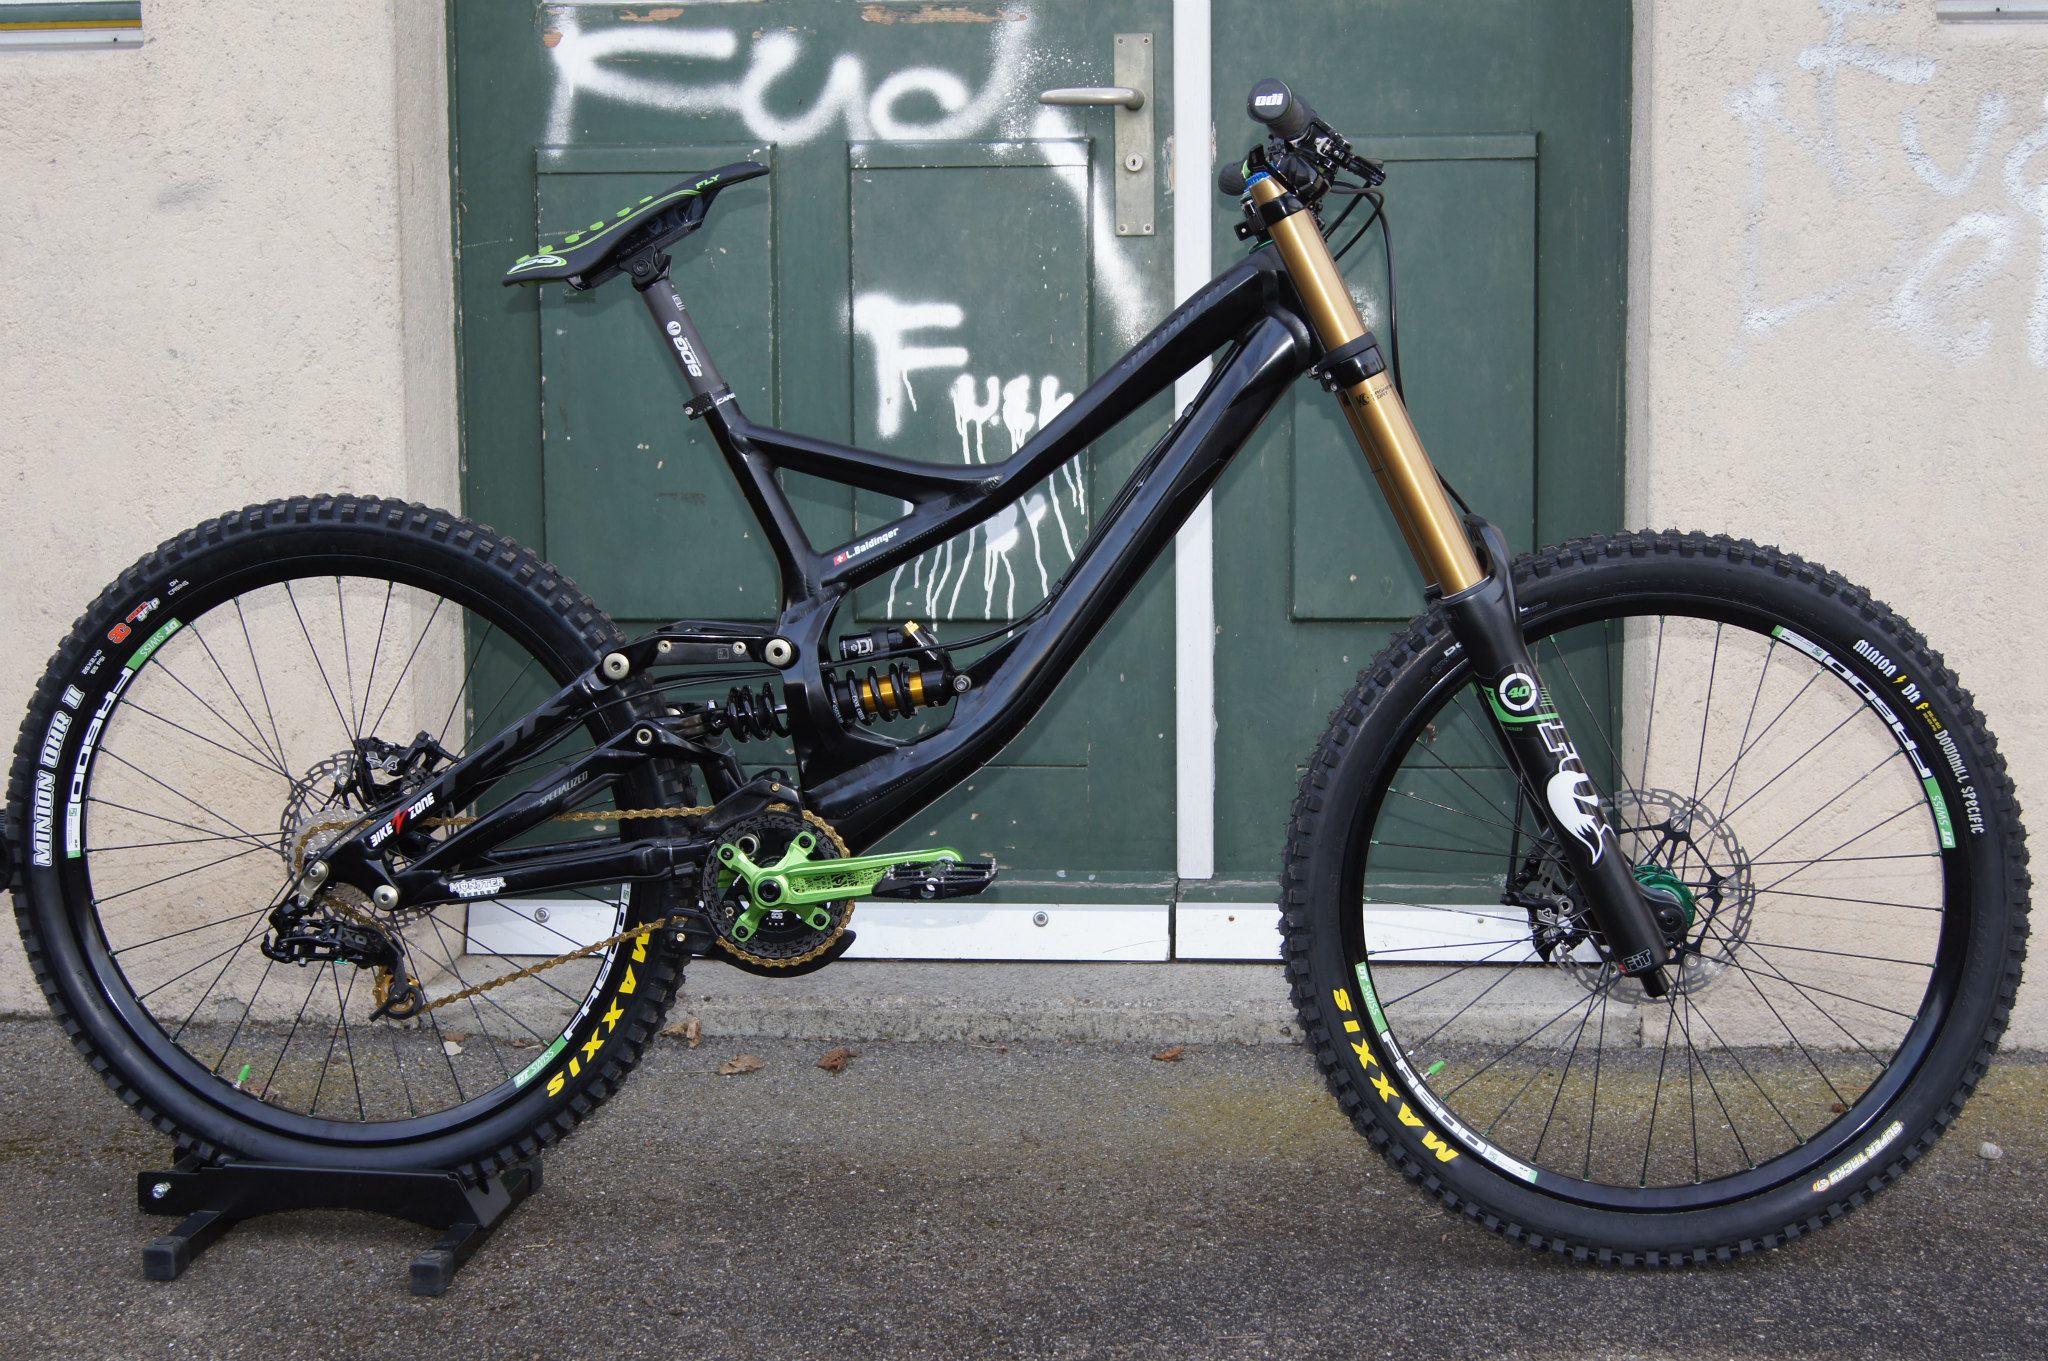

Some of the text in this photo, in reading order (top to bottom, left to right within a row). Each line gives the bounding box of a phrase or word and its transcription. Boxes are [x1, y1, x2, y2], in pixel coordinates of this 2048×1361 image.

[1254, 92, 1284, 107] odi
[695, 174, 721, 190] FLY
[673, 335, 702, 377] SDG
[845, 527, 899, 559] L.Baldinger
[107, 622, 132, 644] 3C
[140, 620, 179, 657] DT SWISS
[1852, 638, 1898, 678] MINION
[1507, 685, 1530, 699] 40
[40, 711, 72, 768] DHR
[539, 770, 589, 807] SPECIALIZED
[33, 770, 56, 867] MINION
[370, 791, 435, 848] BIKE ZONE
[1931, 795, 1953, 846] DT SWISS
[1961, 785, 1985, 835] SPECIFIC
[449, 877, 506, 893] MONSTER
[546, 921, 651, 1098] MAXXIS
[1357, 965, 1380, 1016] DT SWISS
[515, 1048, 555, 1086] DT SWISS
[1333, 987, 1460, 1163] MAXXIS
